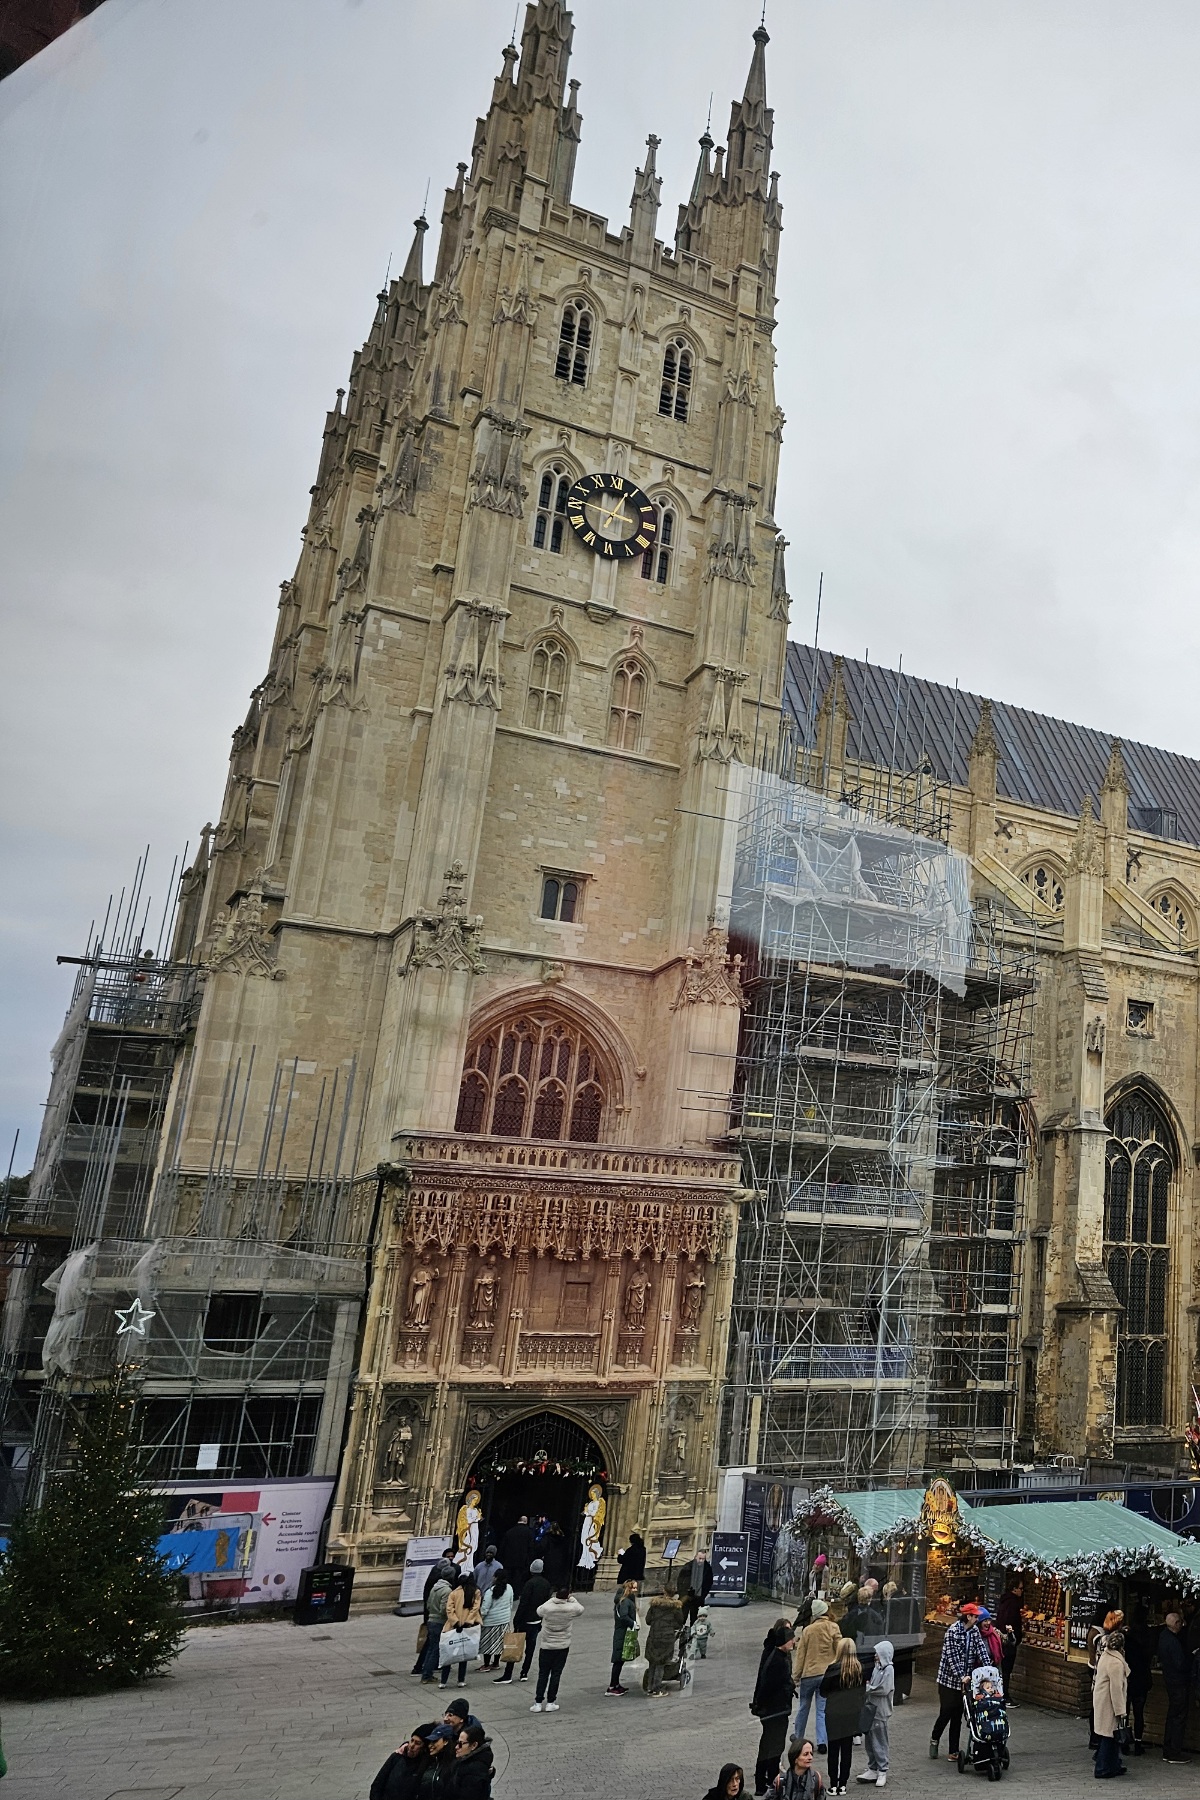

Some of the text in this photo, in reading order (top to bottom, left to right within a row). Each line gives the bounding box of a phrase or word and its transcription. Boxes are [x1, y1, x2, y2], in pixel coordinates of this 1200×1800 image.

[590, 475, 605, 488] XI
[610, 475, 624, 490] XII
[574, 482, 590, 496] X
[629, 488, 640, 497] I
[642, 521, 656, 532] III
[624, 543, 634, 557] V
[714, 1544, 744, 1553] Entrance
